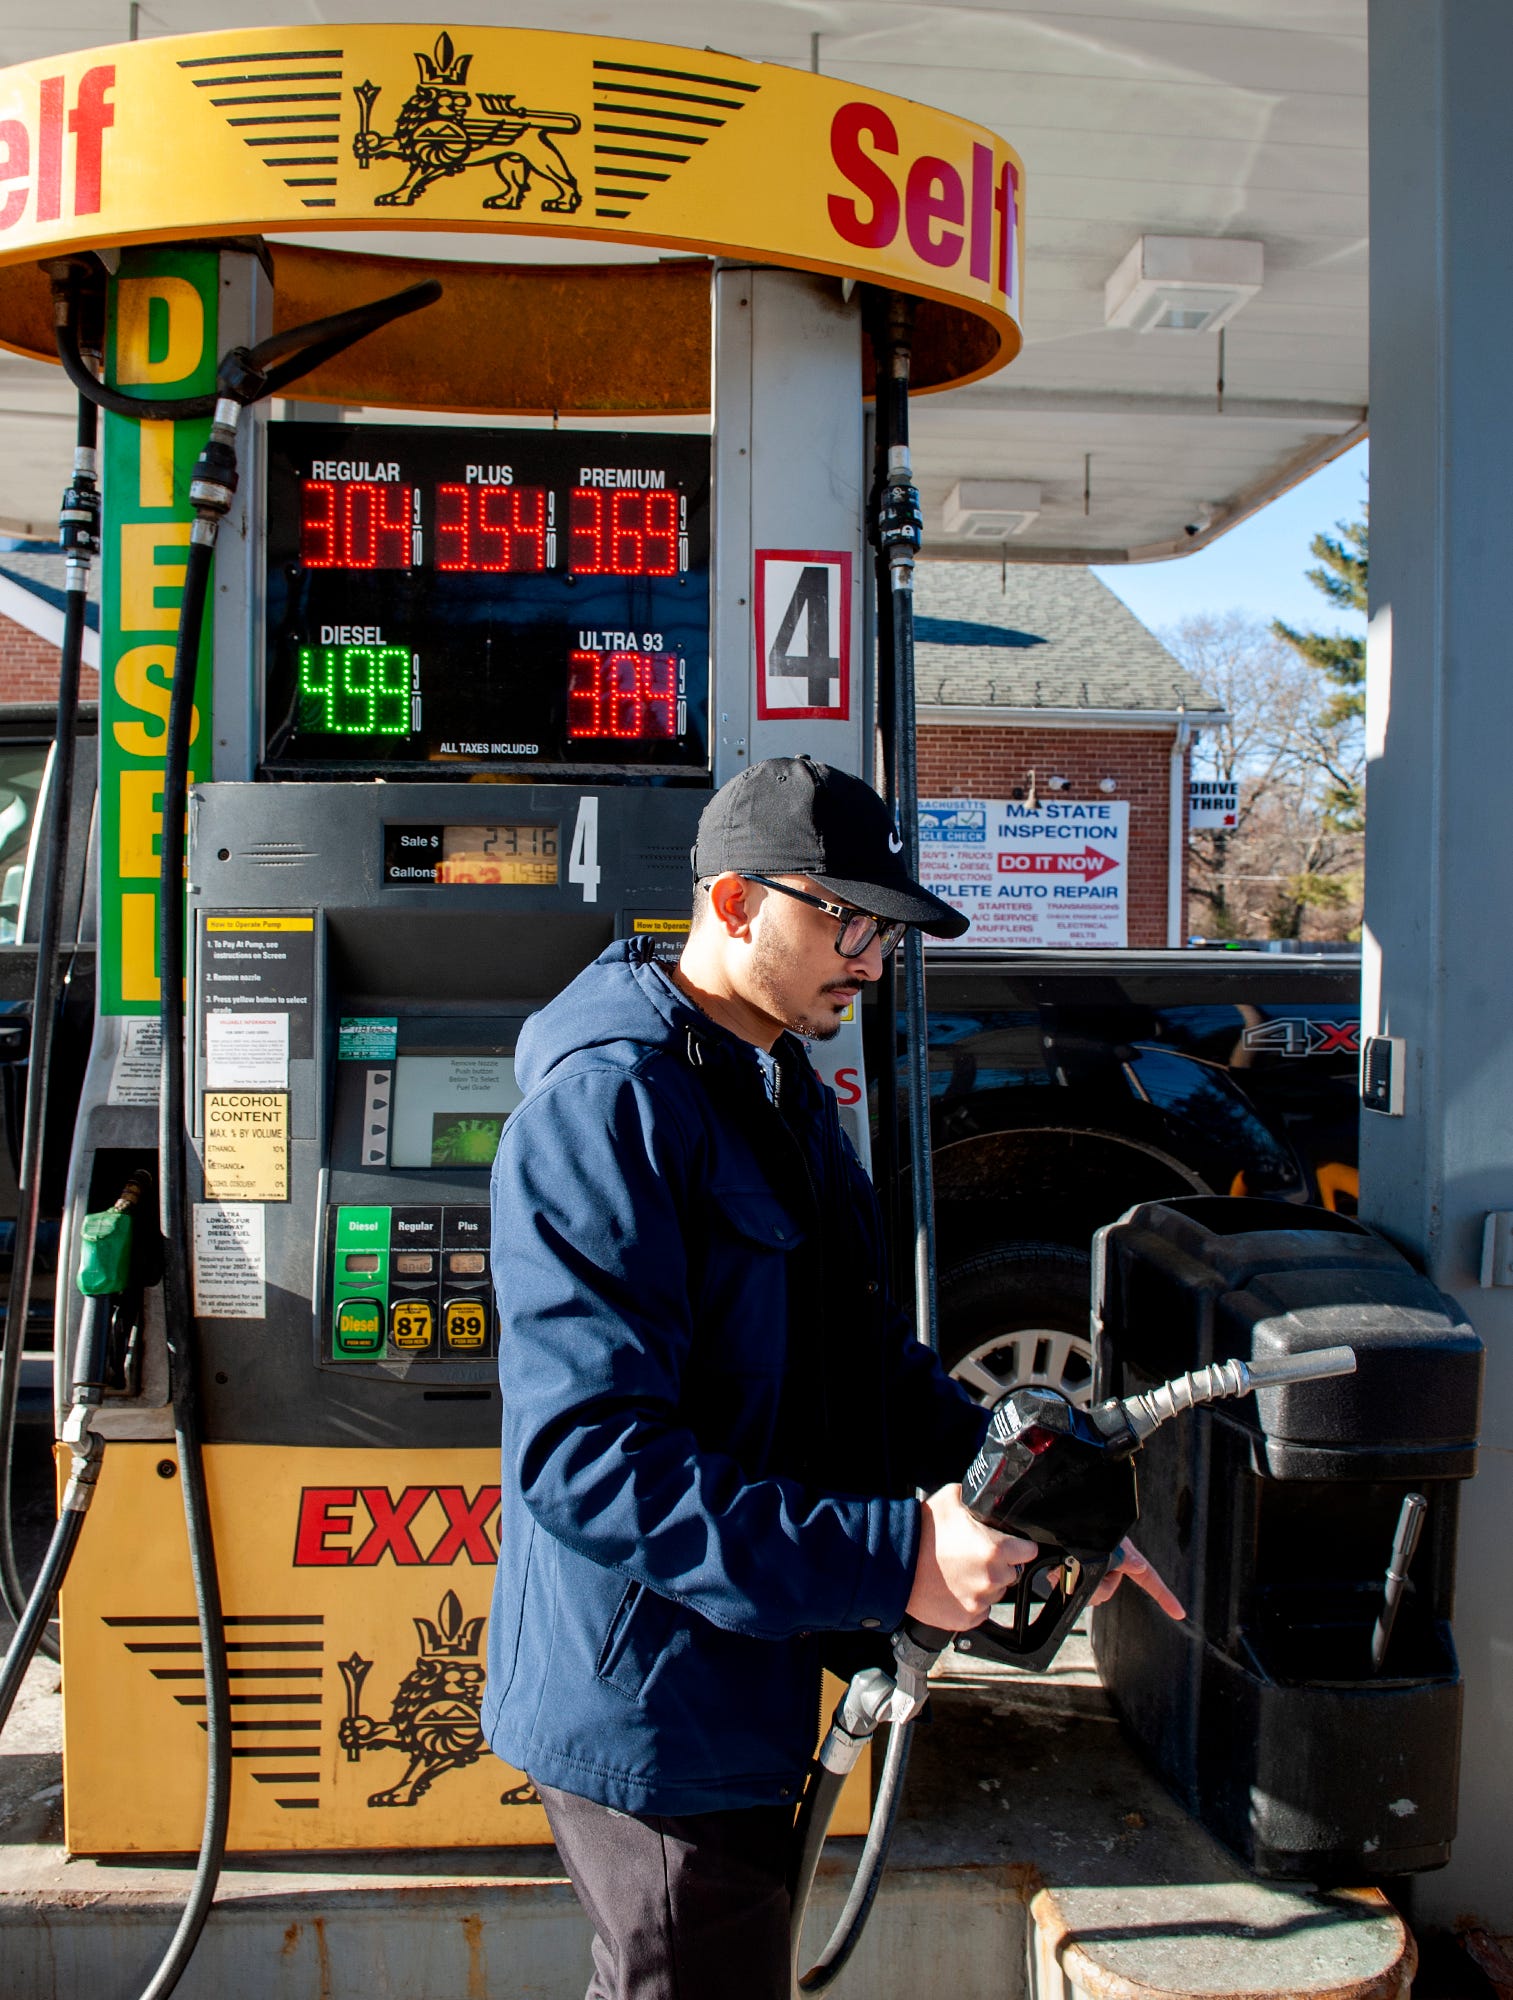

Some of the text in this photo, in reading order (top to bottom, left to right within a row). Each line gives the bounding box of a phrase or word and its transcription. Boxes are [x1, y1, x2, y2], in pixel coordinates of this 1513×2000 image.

[827, 101, 1019, 300] Self
[312, 461, 400, 482] REGULAR
[466, 465, 514, 485] PLUS
[580, 468, 665, 489] PREMIUM
[304, 483, 411, 567] 3.04
[440, 487, 544, 571] 3.54
[574, 491, 676, 576] 3.69
[320, 626, 387, 646] DIESEL
[579, 632, 663, 652] ULTRA 93
[769, 567, 840, 707] 4
[440, 742, 539, 755] ALL TAXES INCLUDED
[1190, 783, 1238, 795] DRIVE
[1191, 798, 1236, 810] THRU
[1006, 804, 1111, 819] MA STATE
[946, 831, 984, 841] CHECK
[998, 824, 1118, 839] INSPECTION
[401, 835, 439, 849] Sale $
[568, 796, 601, 903] 4
[1001, 856, 1105, 871] DO IT NOW
[389, 866, 438, 878] Gallons
[933, 873, 993, 881] INSPECTIONS
[998, 885, 1048, 898] AUTO
[1054, 886, 1118, 898] REPAIR
[993, 914, 1038, 922] SERVICE
[637, 921, 653, 929] How
[663, 922, 690, 930] Operate
[223, 941, 235, 949] Pay
[662, 942, 675, 950] Pay
[263, 951, 287, 959] Screen
[232, 996, 255, 1004] yellow
[211, 1096, 282, 1107] ALCOHOL
[211, 1111, 282, 1122] CONTENT
[239, 1129, 249, 1138] BY
[252, 1129, 282, 1138] VOLUME
[348, 1221, 378, 1231] Diesel
[398, 1221, 434, 1232] Regular
[458, 1221, 478, 1231] Plus
[341, 1315, 379, 1332] Diesel
[397, 1317, 428, 1337] 87
[450, 1317, 481, 1336] 89
[293, 1485, 502, 1567] EXX
